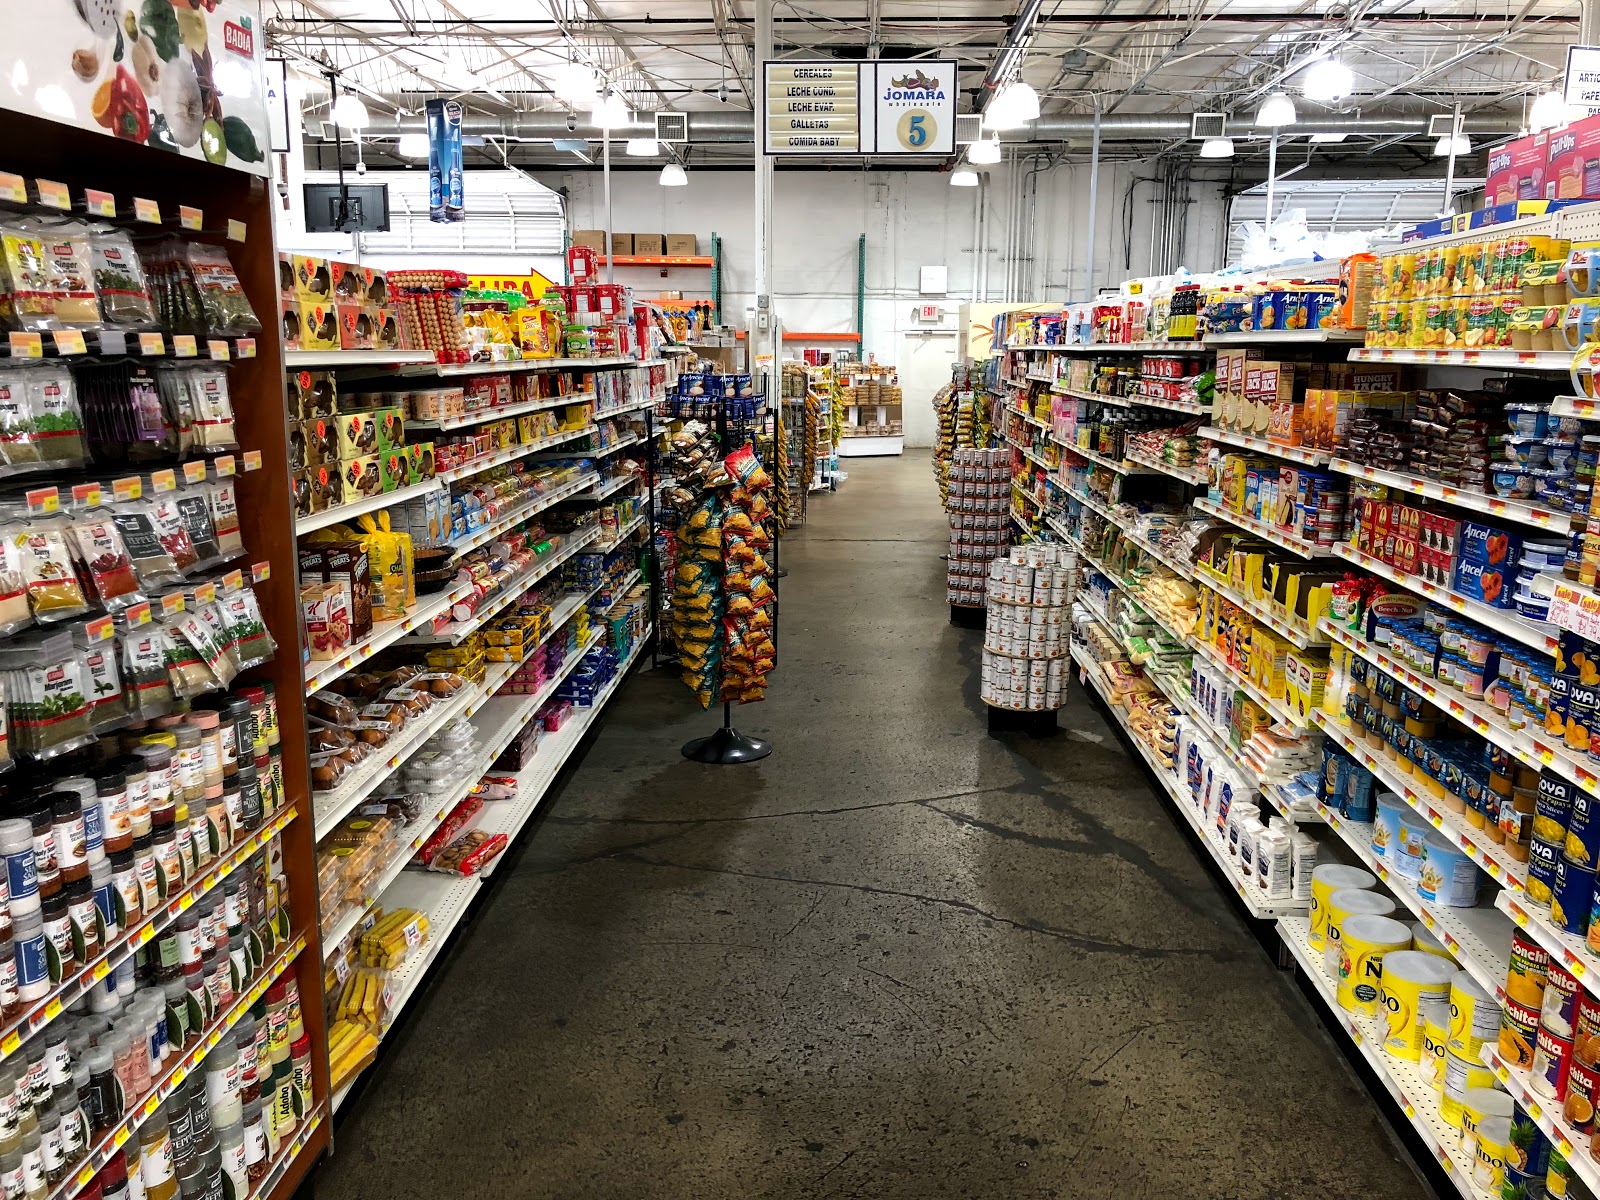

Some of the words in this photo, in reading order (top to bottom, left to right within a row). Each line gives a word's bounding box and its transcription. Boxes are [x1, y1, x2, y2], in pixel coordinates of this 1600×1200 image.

[225, 28, 251, 52] BADIA
[794, 69, 832, 78] CEREALES
[1579, 73, 1600, 82] ARTIC
[787, 87, 811, 96] LECHE
[813, 87, 835, 96] COND.
[1581, 91, 1600, 100] PAPE
[788, 103, 812, 112] LECHE
[814, 103, 834, 111] EVAP.
[791, 120, 828, 128] GALLETAS
[909, 116, 926, 145] 5
[789, 138, 817, 146] COMIDA
[820, 138, 839, 146] BABY
[1314, 294, 1335, 304] Anc
[924, 307, 936, 317] EXIT
[1569, 308, 1580, 317] Dole
[1261, 379, 1276, 391] JACK
[1353, 375, 1394, 383] HUNGRY
[1353, 383, 1393, 391] JACK
[1464, 524, 1490, 540] Ancel
[301, 557, 322, 569] TREATS
[330, 556, 350, 568] TREATS
[1459, 560, 1484, 576] Ancel
[308, 601, 320, 615] K
[1584, 600, 1597, 609] sale
[44, 678, 72, 691] Marjoram
[1550, 677, 1566, 691] YA
[1571, 687, 1594, 704] OYA
[153, 781, 171, 789] BACO
[1539, 779, 1565, 797] OYA
[1575, 794, 1586, 811] YA
[1531, 840, 1552, 859] OYA
[1327, 923, 1340, 940] ID
[1512, 940, 1549, 964] Conchi
[1549, 970, 1577, 992] chita
[1380, 989, 1399, 1012] DO
[1581, 1002, 1600, 1023] nchi
[1423, 1034, 1445, 1058] IDO
[1538, 1032, 1562, 1055] chita
[56, 1052, 66, 1062] Bay
[1570, 1064, 1593, 1088] chita
[280, 1086, 289, 1115] Adobo
[65, 1122, 76, 1131] Bay
[50, 1139, 60, 1148] Bay
[172, 1135, 192, 1149] PEPP
